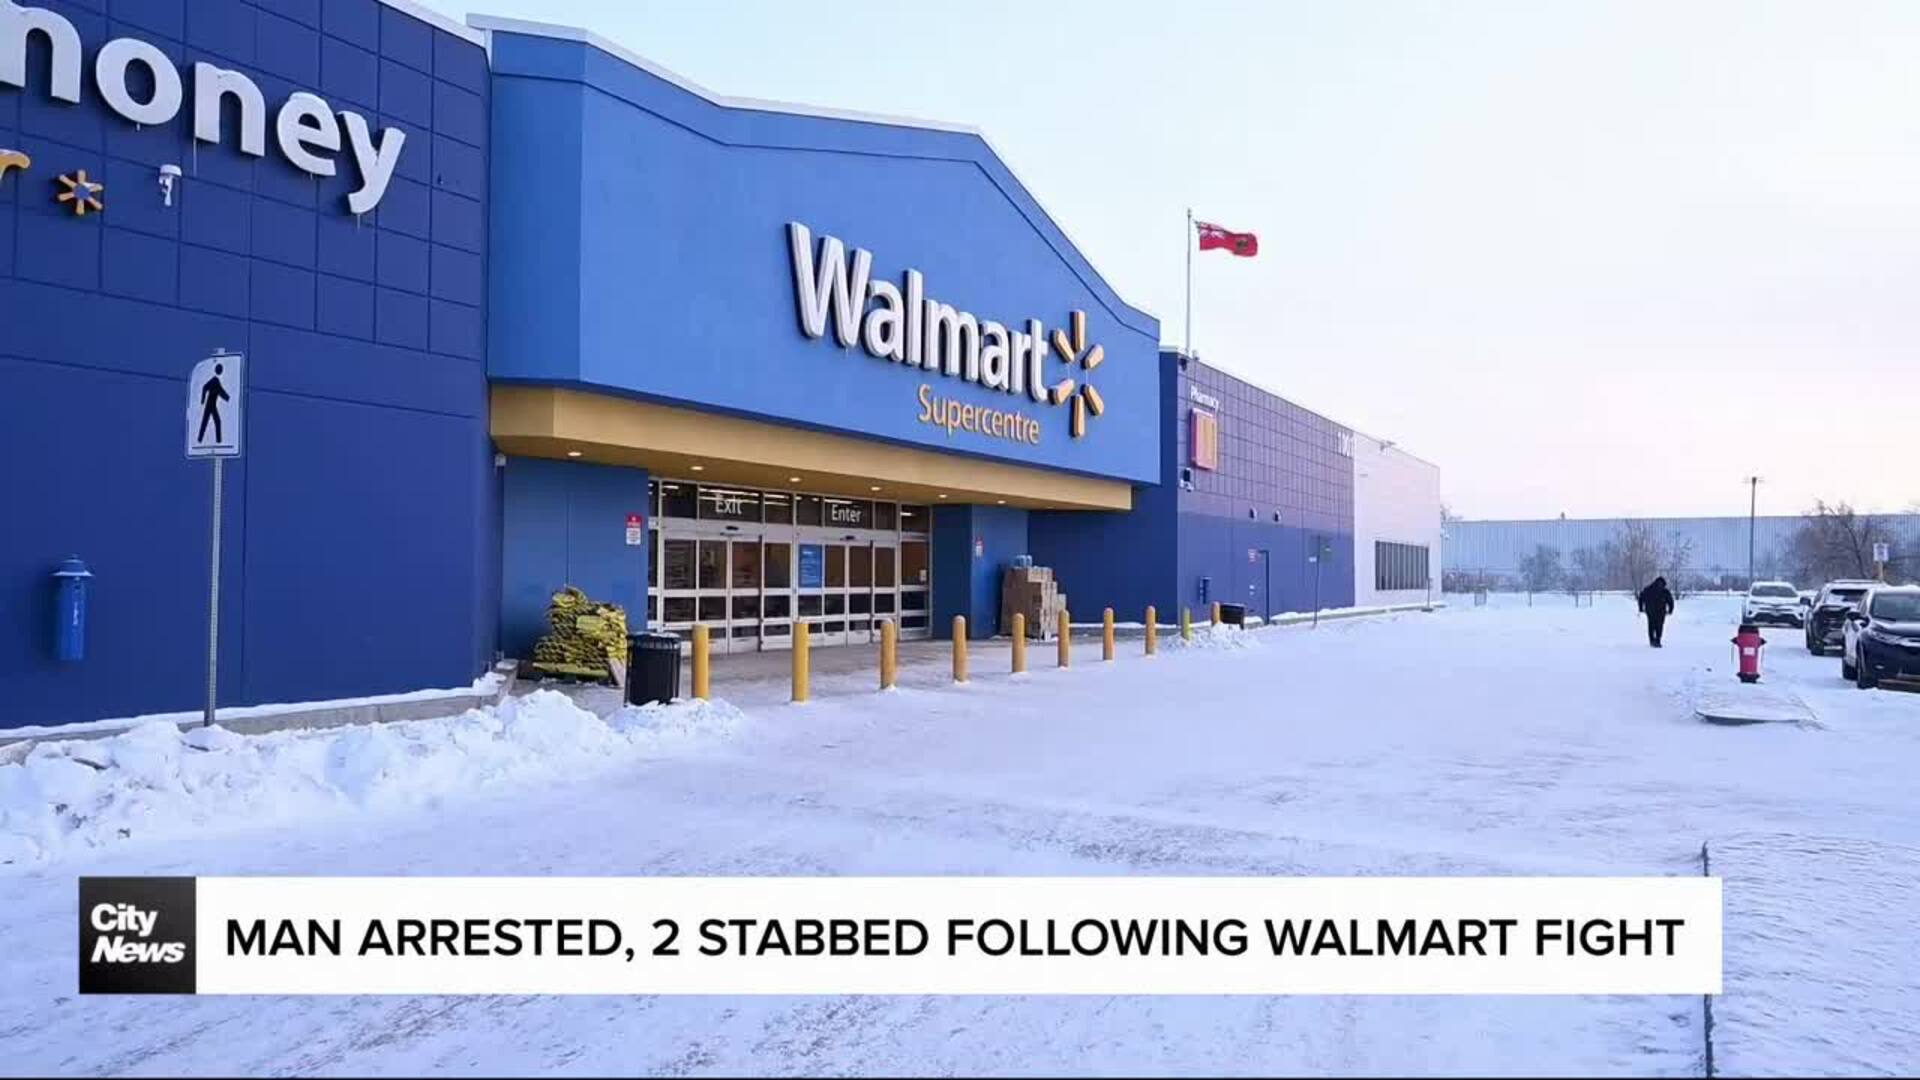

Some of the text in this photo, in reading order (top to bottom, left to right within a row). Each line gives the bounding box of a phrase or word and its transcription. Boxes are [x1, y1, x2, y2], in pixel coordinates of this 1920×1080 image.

[788, 221, 1048, 402] Walmart
[917, 383, 1040, 445] Supercentre
[714, 495, 743, 516] Exit
[831, 504, 863, 524] Enter
